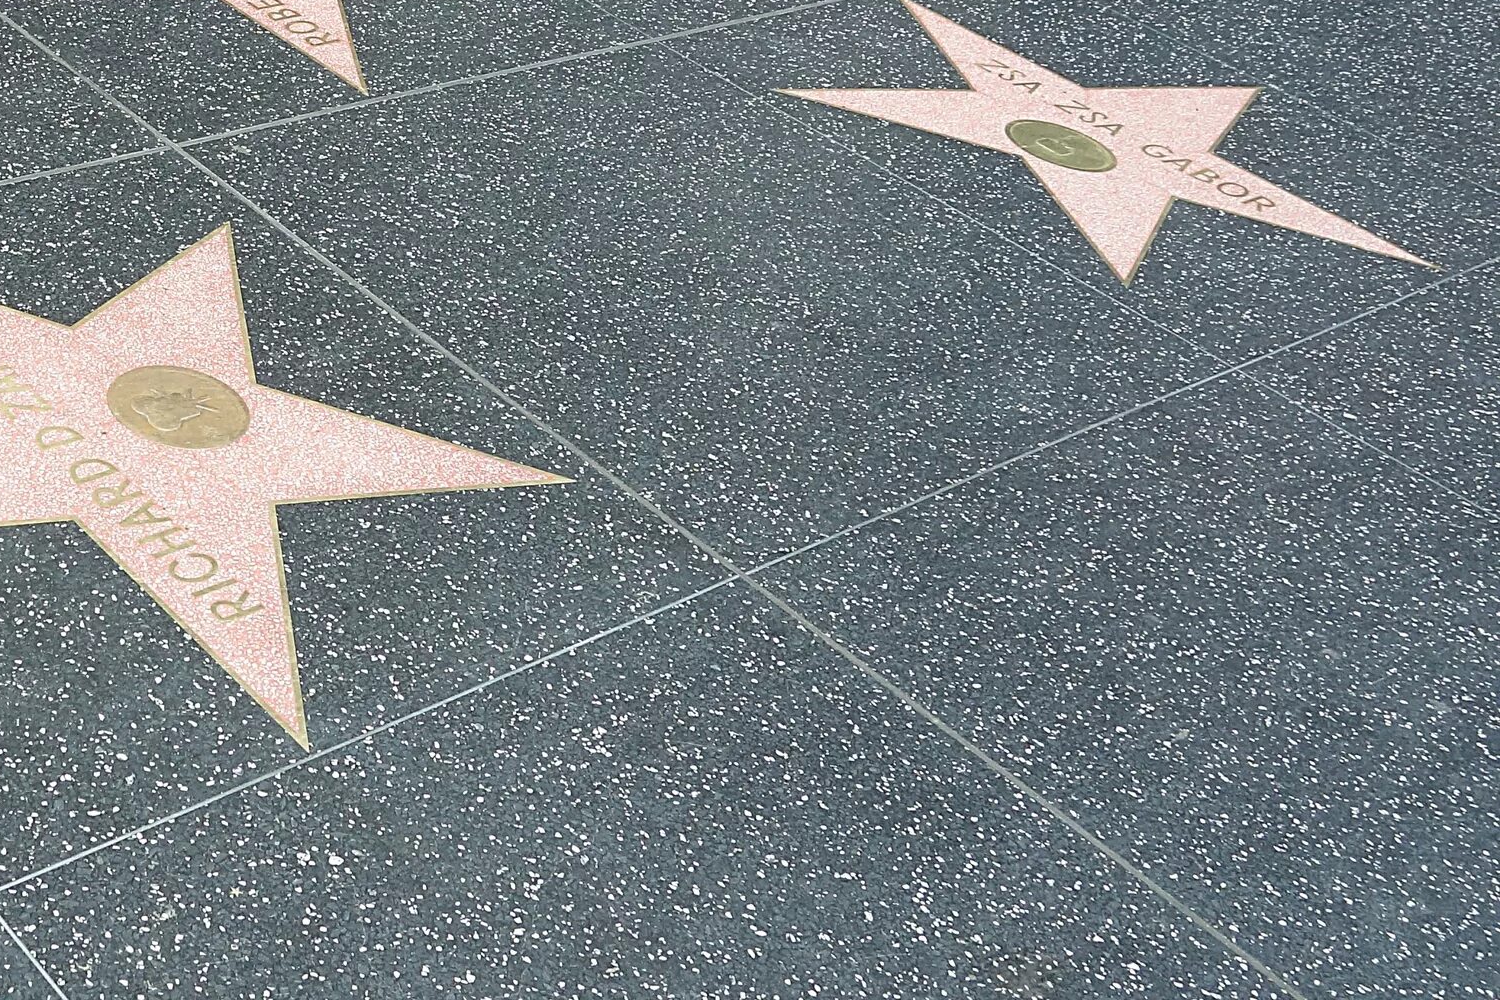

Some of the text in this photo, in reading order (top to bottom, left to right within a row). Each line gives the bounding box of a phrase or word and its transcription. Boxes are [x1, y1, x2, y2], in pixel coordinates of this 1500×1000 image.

[973, 58, 1279, 215] ZSA ZSA GABOR
[34, 422, 84, 454] D
[68, 454, 267, 625] RICHARD
